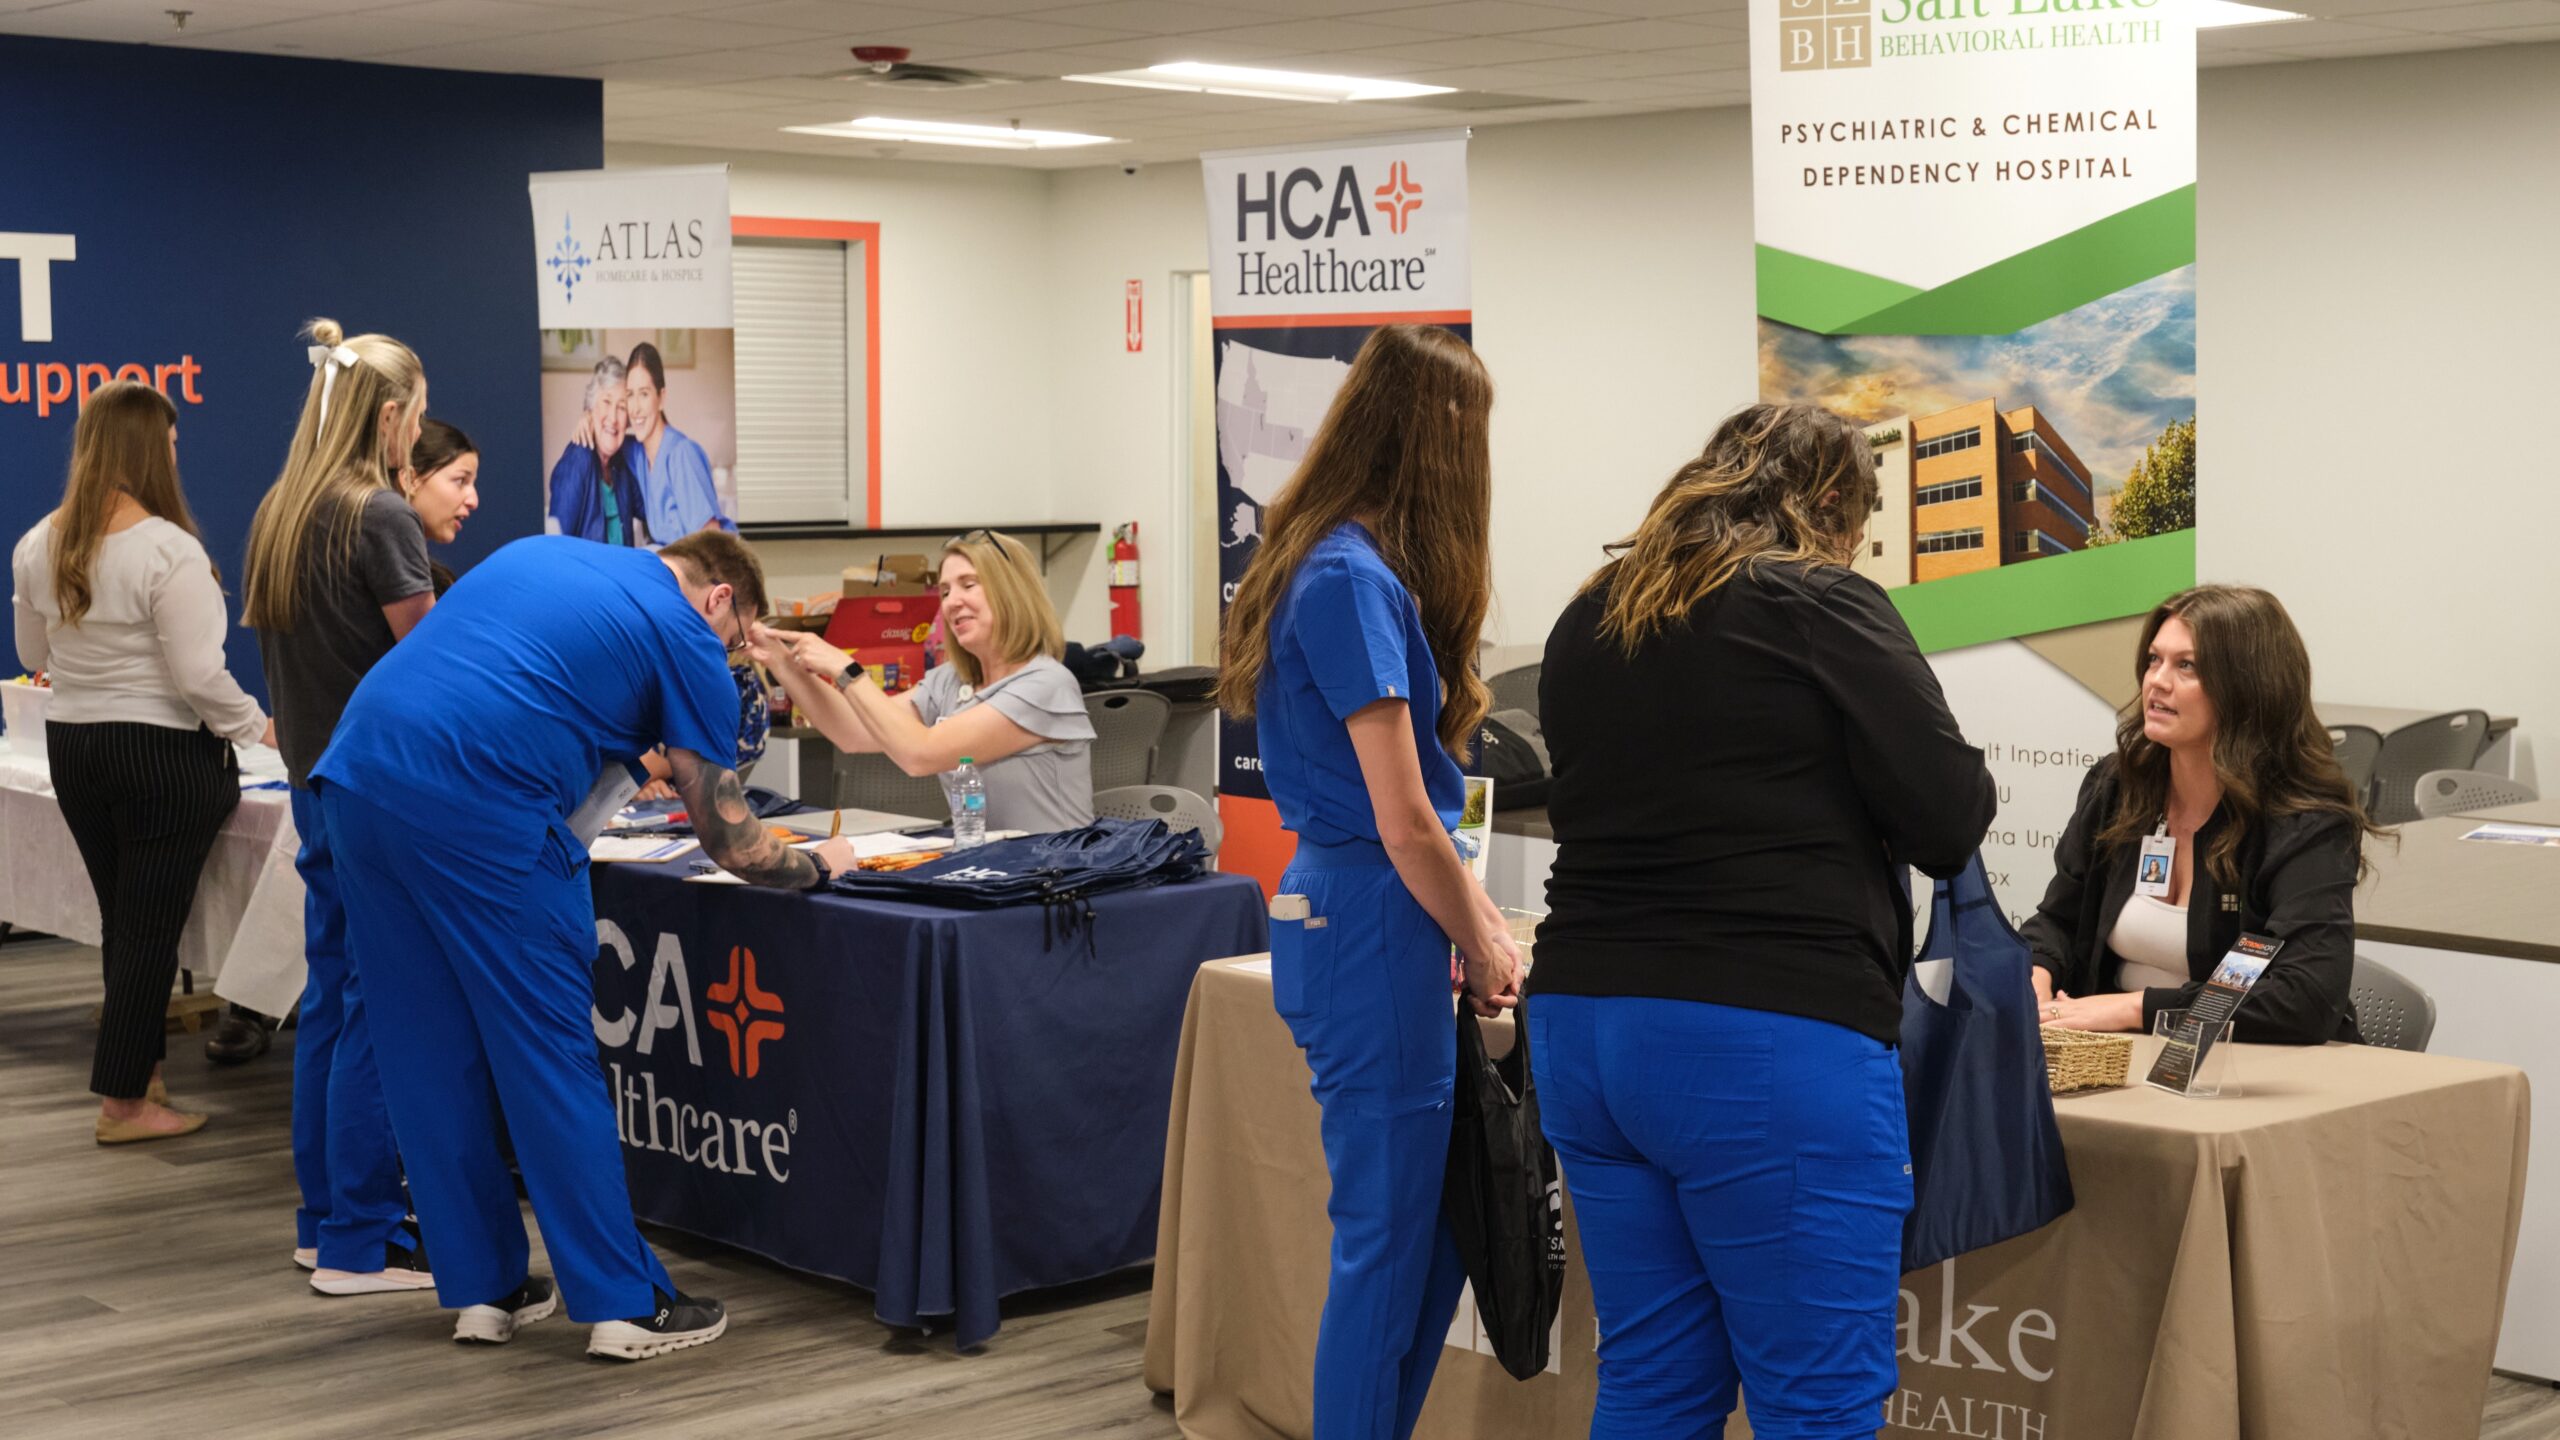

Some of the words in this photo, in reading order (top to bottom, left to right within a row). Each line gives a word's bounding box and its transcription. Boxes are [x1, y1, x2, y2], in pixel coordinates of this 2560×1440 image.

[1880, 27, 2044, 57] BEHAVIORAL
[2051, 20, 2161, 47] HEALTH
[1782, 117, 1957, 144] PSYCHIATRIC
[1972, 117, 1987, 137] &
[2003, 109, 2158, 135] CHEMICAL
[1803, 162, 1979, 187] DEPENDENCY
[1996, 157, 2133, 181] HOSPITAL
[1237, 165, 1371, 241] HCA
[596, 219, 703, 261] ATLAS
[596, 270, 648, 283] HOMECARE
[662, 268, 703, 281] HOSPICE
[1237, 248, 1425, 296] Healthcare
